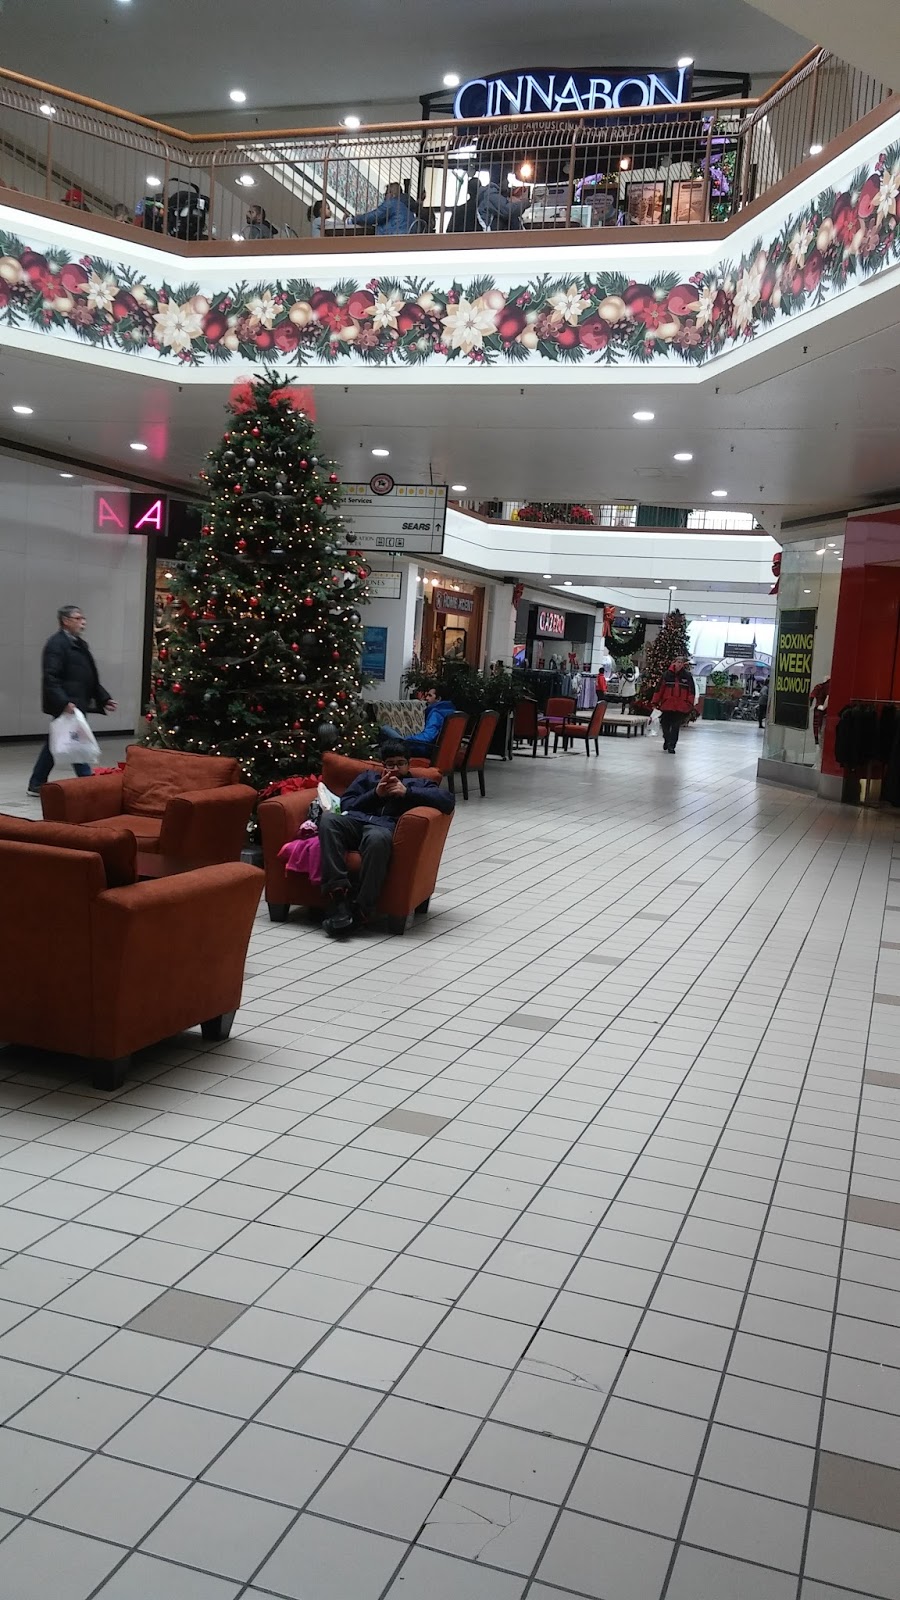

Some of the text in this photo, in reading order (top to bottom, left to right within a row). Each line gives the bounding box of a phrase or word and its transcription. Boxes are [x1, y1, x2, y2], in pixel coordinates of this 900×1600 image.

[454, 67, 687, 119] CINNABON
[134, 499, 162, 530] A
[401, 522, 431, 532] SEARS
[780, 633, 814, 650] BOXING
[779, 652, 812, 674] WEEK
[776, 677, 811, 694] BLOWOUT
